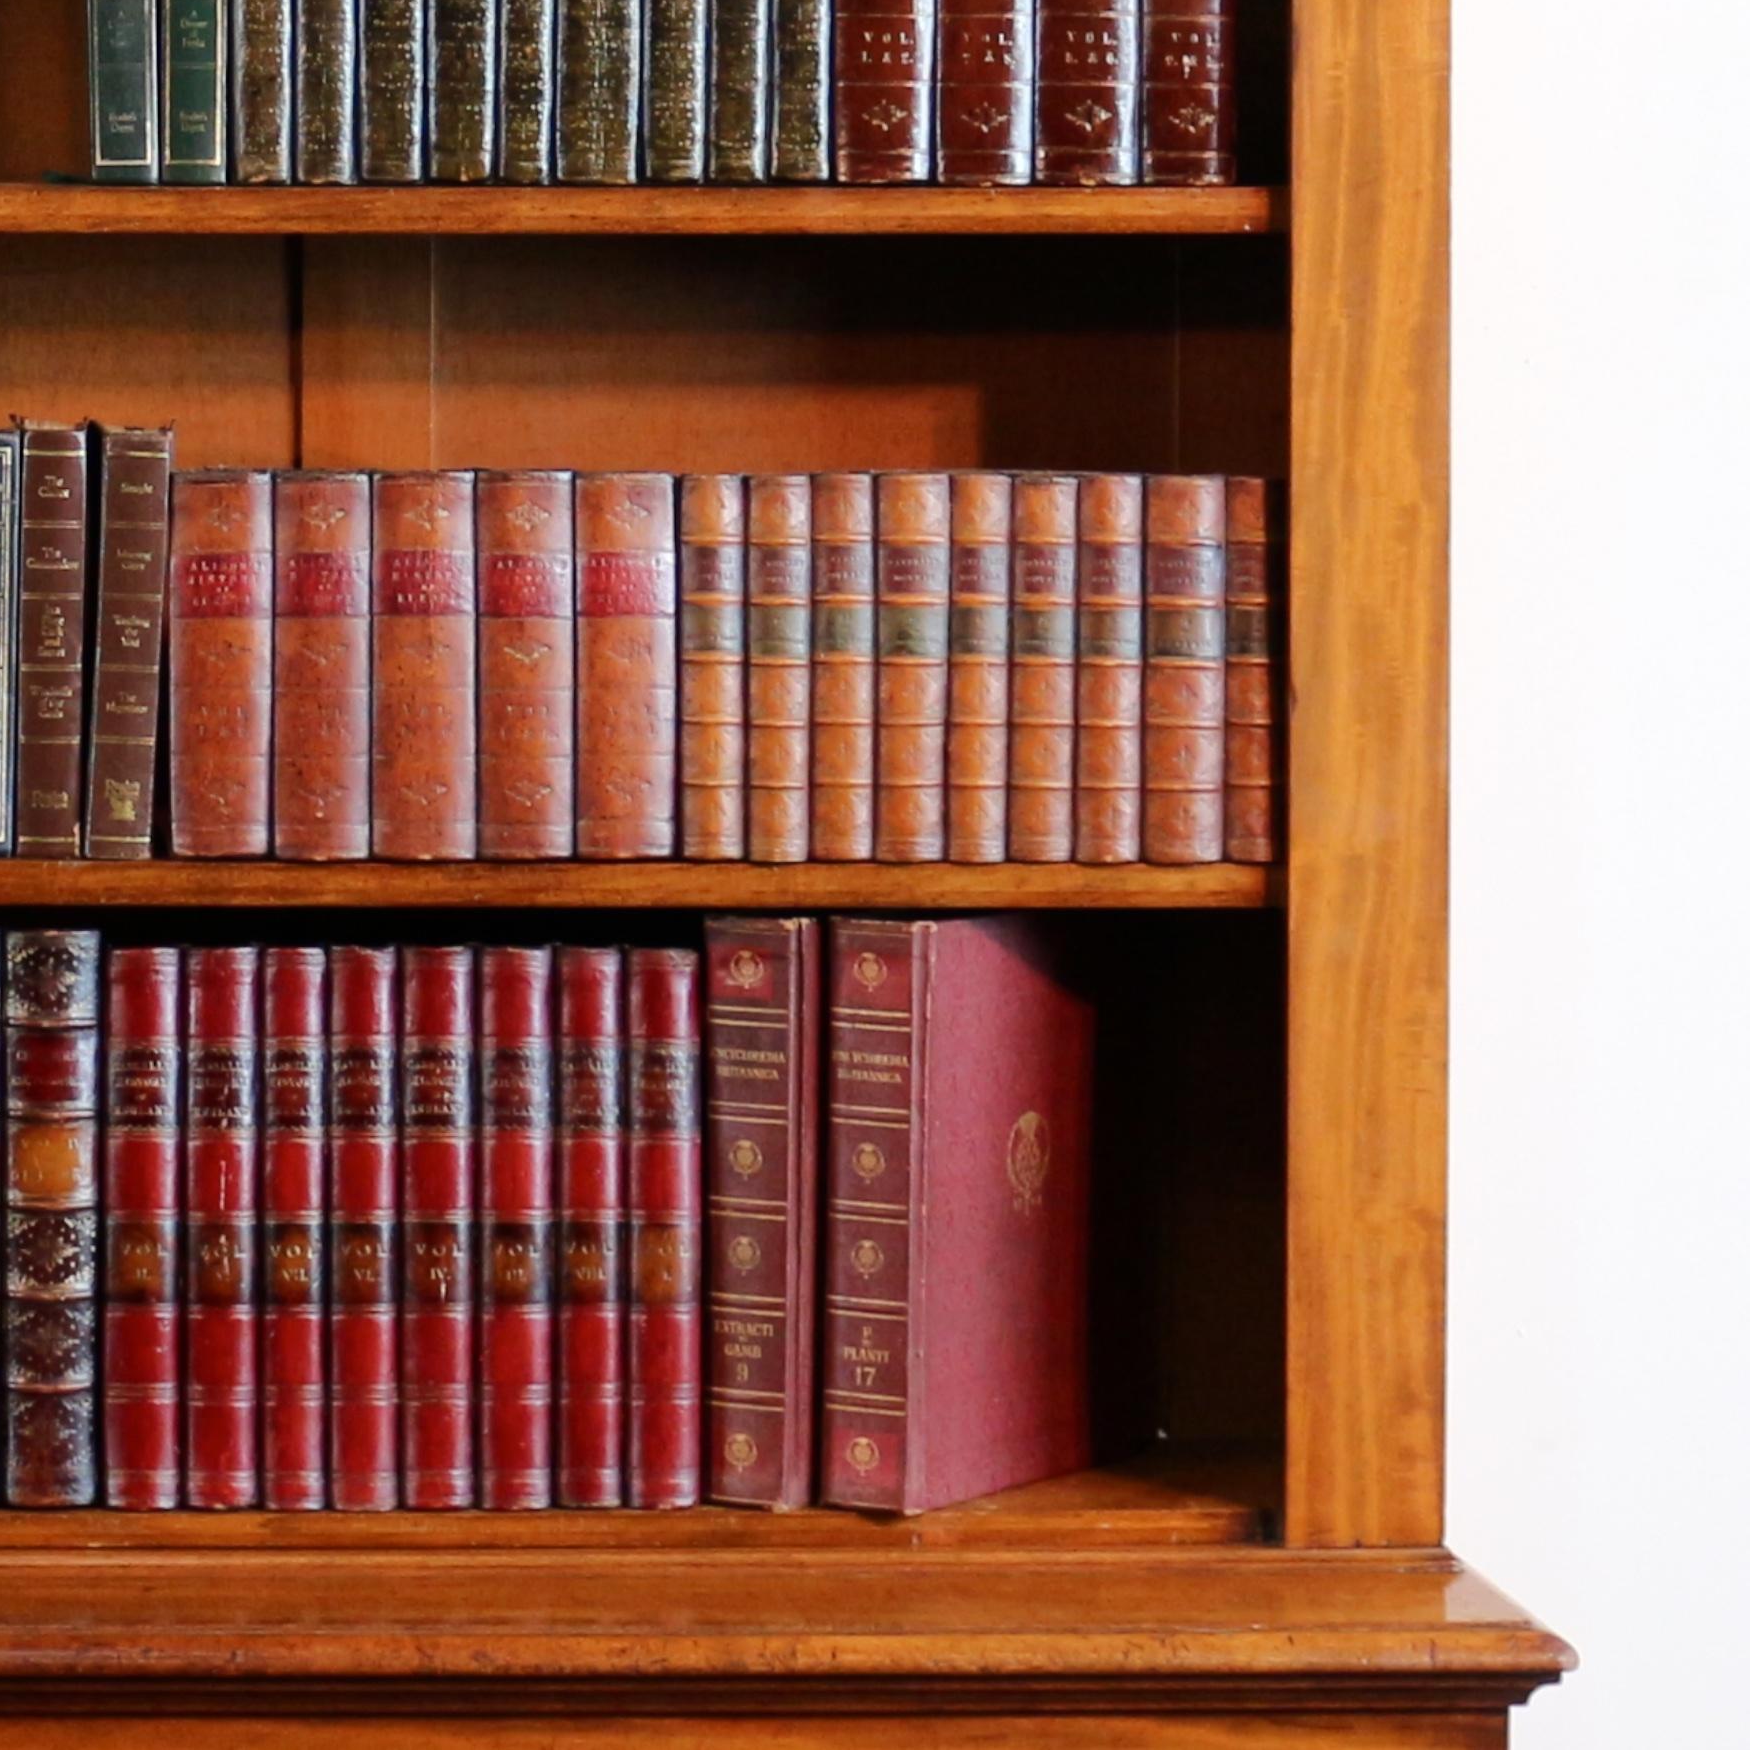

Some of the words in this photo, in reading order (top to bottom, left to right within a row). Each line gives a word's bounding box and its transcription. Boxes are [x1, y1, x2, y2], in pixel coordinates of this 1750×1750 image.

[843, 1346, 890, 1363] PLANTI
[737, 1363, 749, 1382] 9
[855, 1367, 877, 1387] 17
